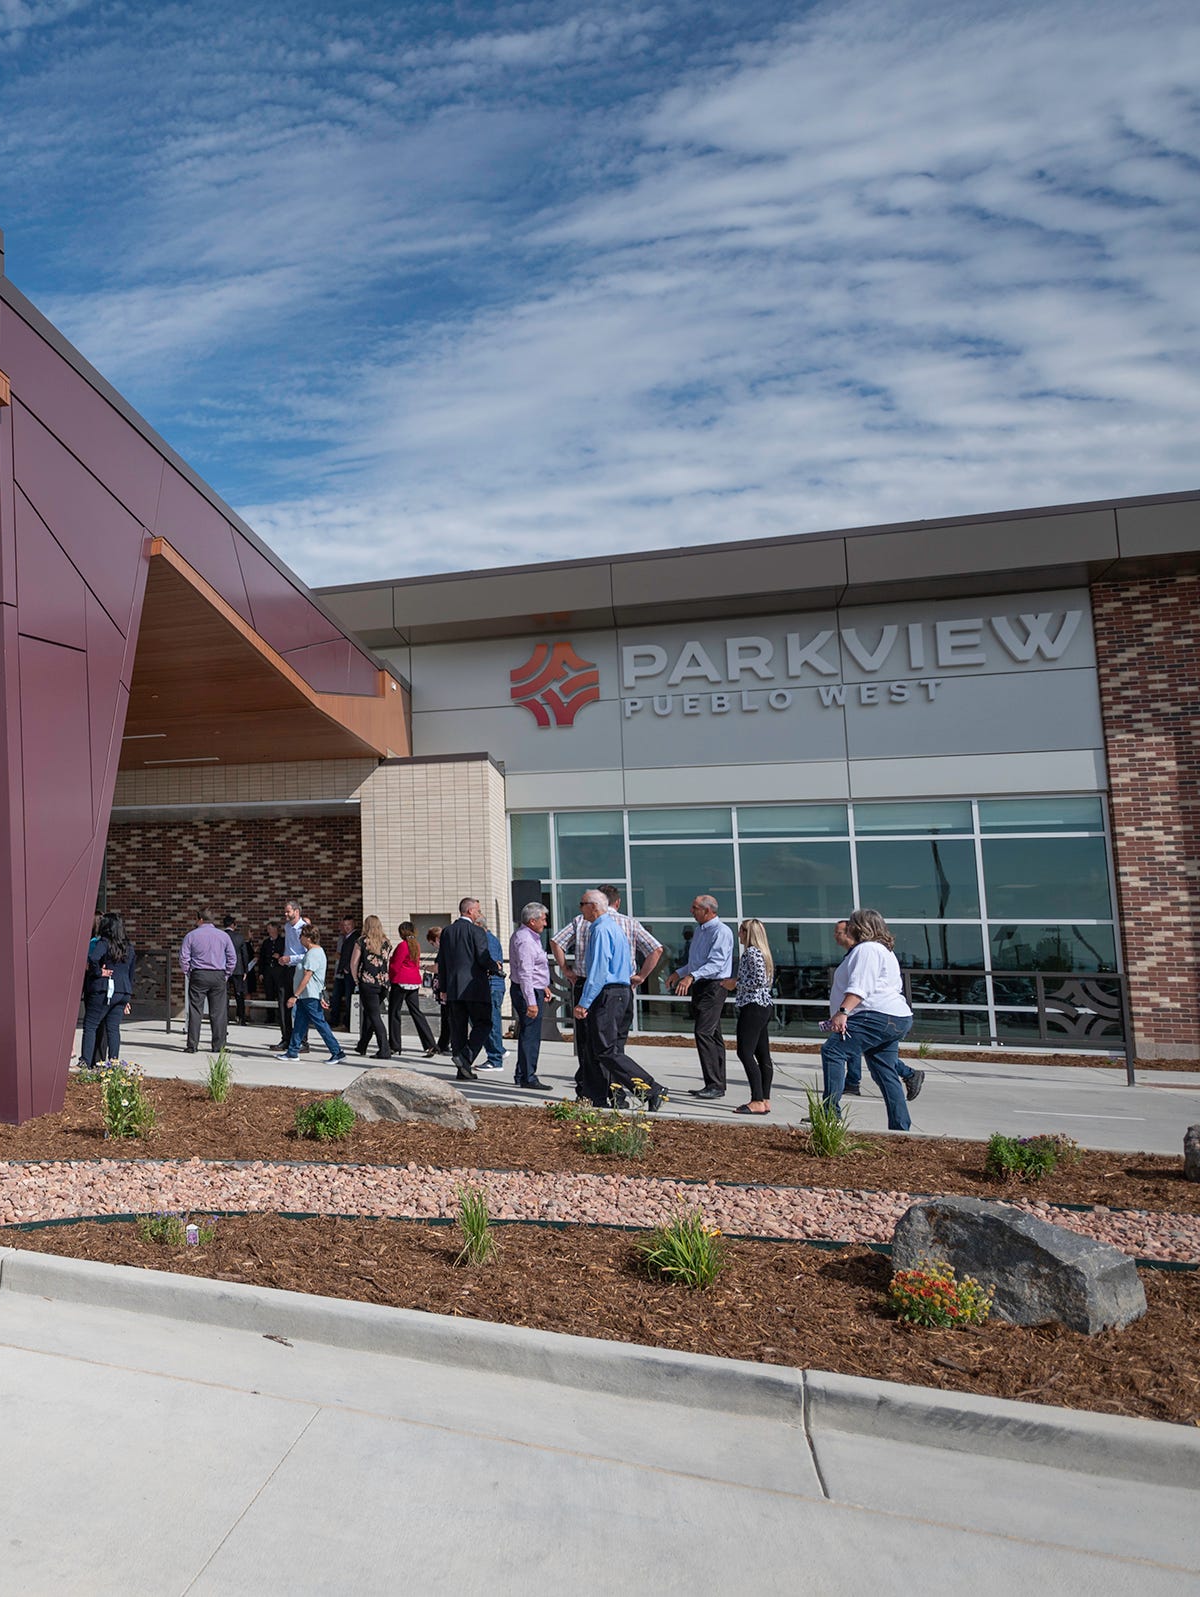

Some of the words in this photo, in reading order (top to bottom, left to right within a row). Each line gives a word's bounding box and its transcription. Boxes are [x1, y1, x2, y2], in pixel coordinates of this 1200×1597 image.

[622, 610, 1083, 689] PARKVIEW
[625, 688, 793, 719] PUEBLO
[818, 678, 942, 708] WEST
